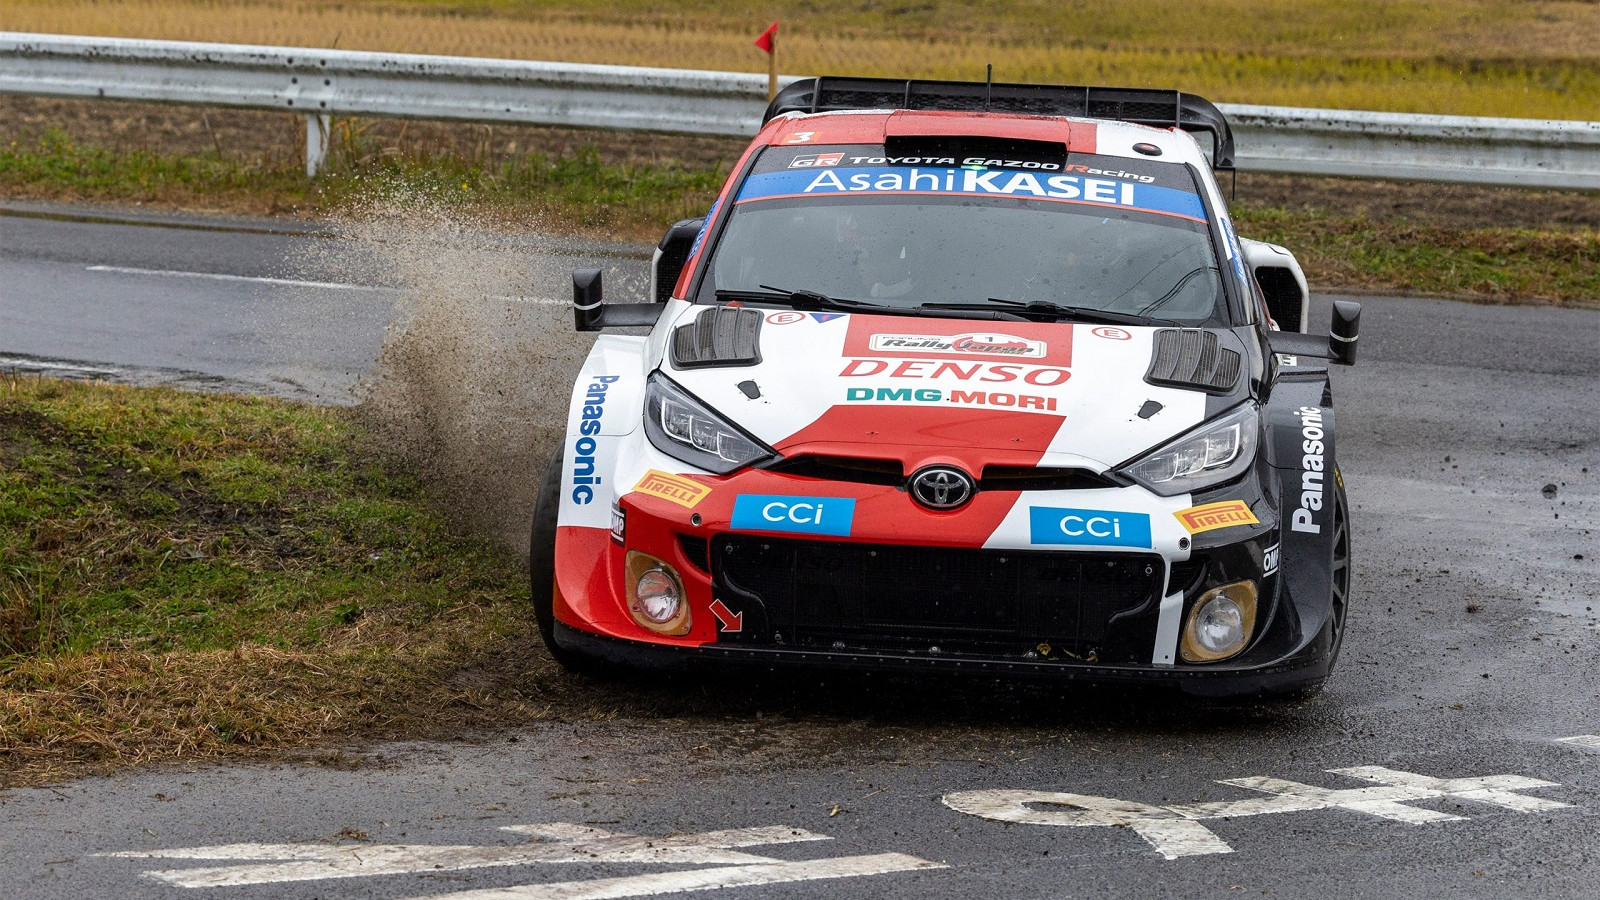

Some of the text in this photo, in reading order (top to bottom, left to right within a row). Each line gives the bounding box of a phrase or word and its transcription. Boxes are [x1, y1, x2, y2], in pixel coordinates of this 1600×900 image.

[787, 131, 815, 143] 3
[790, 155, 1155, 184] GR TOYOTA GAZOO Racing
[881, 339, 953, 350] Rally
[957, 342, 1035, 355] Japan
[839, 359, 1072, 387] DENSO
[847, 387, 1057, 411] DMG MORI
[572, 375, 620, 505] Panasonic
[1291, 406, 1324, 534] Panasonic
[639, 473, 704, 504] PIRELLI
[1182, 504, 1251, 530] PIRELLI
